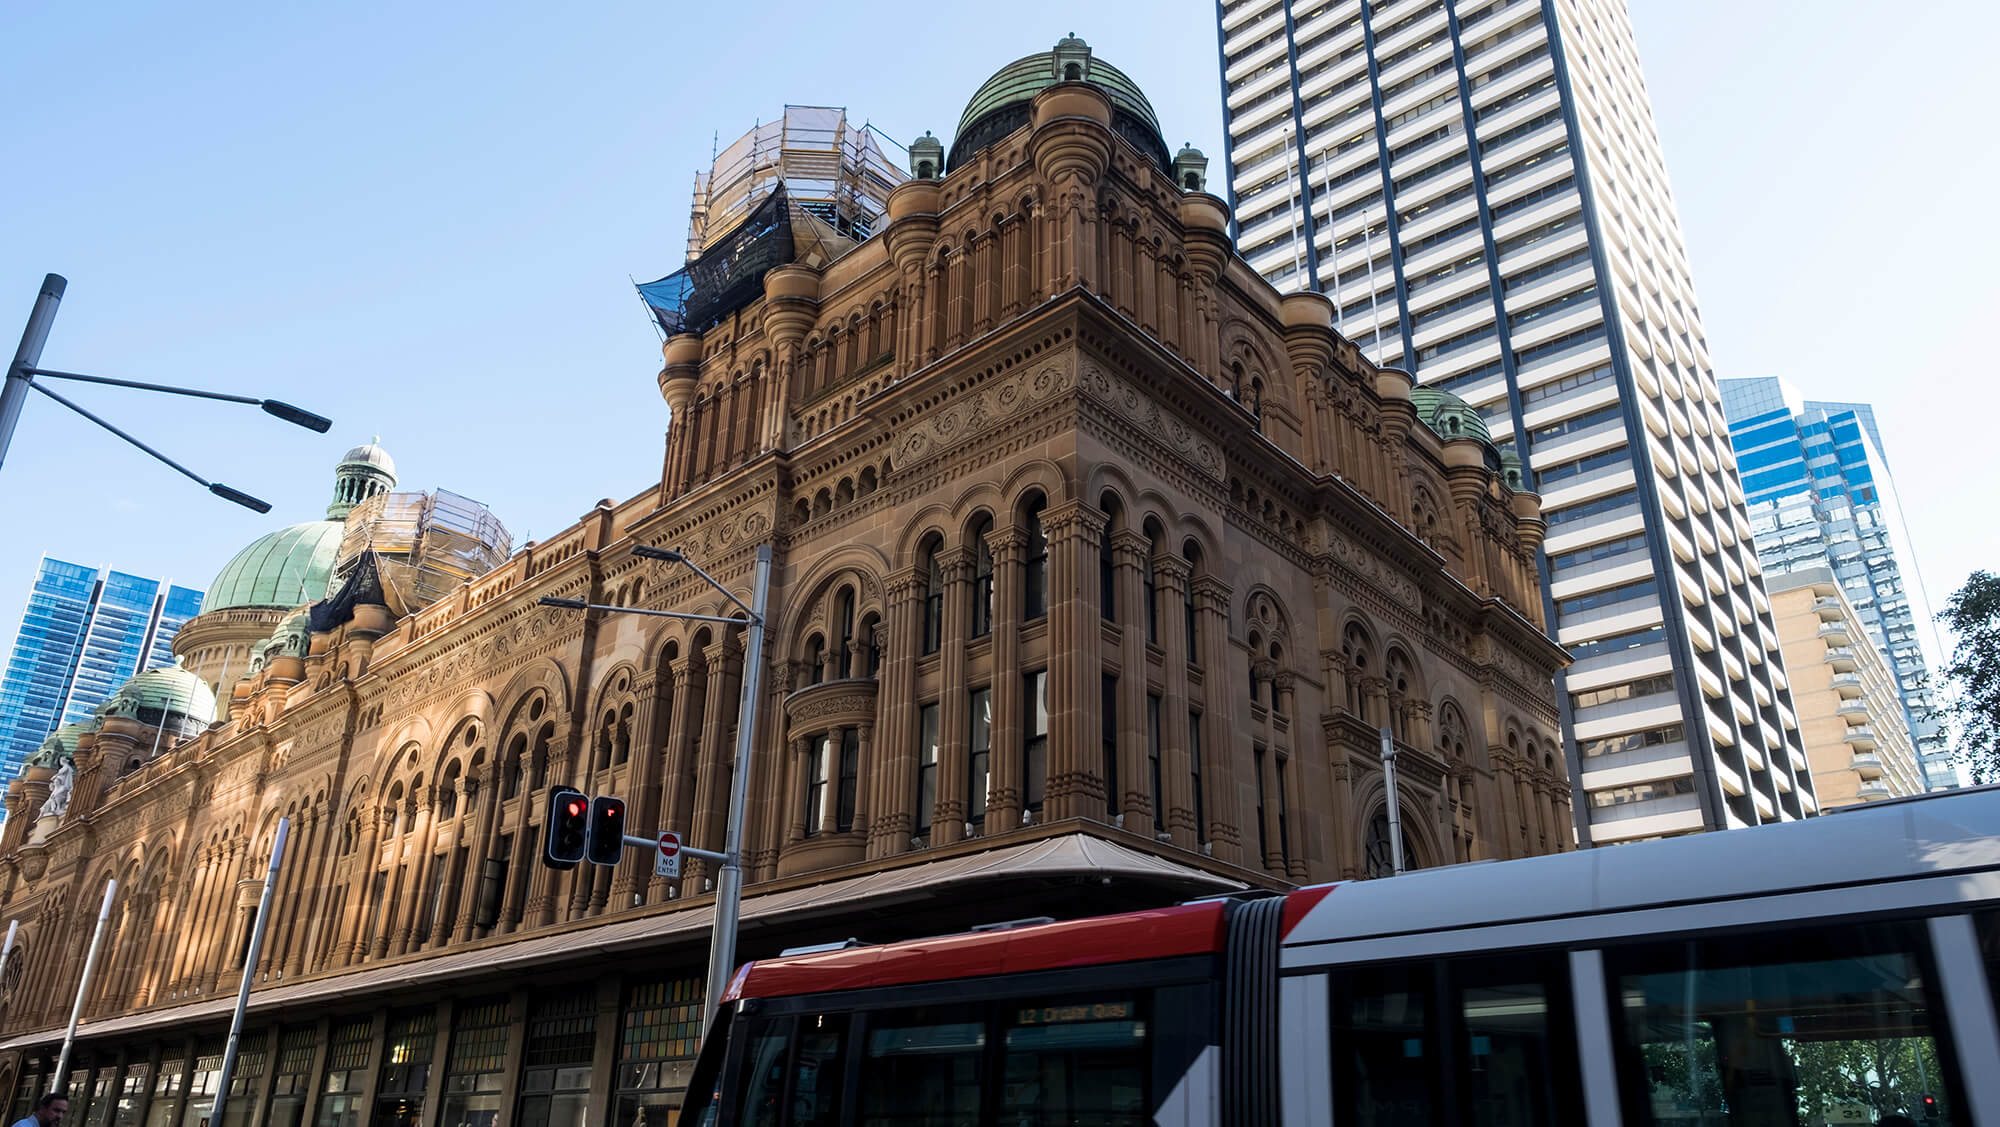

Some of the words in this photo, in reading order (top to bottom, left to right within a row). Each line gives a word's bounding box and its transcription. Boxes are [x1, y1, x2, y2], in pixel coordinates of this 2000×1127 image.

[662, 858, 674, 866] NO
[658, 866, 678, 875] ENTRY
[1019, 1009, 1035, 1023] L2
[1093, 1004, 1127, 1018] Quay
